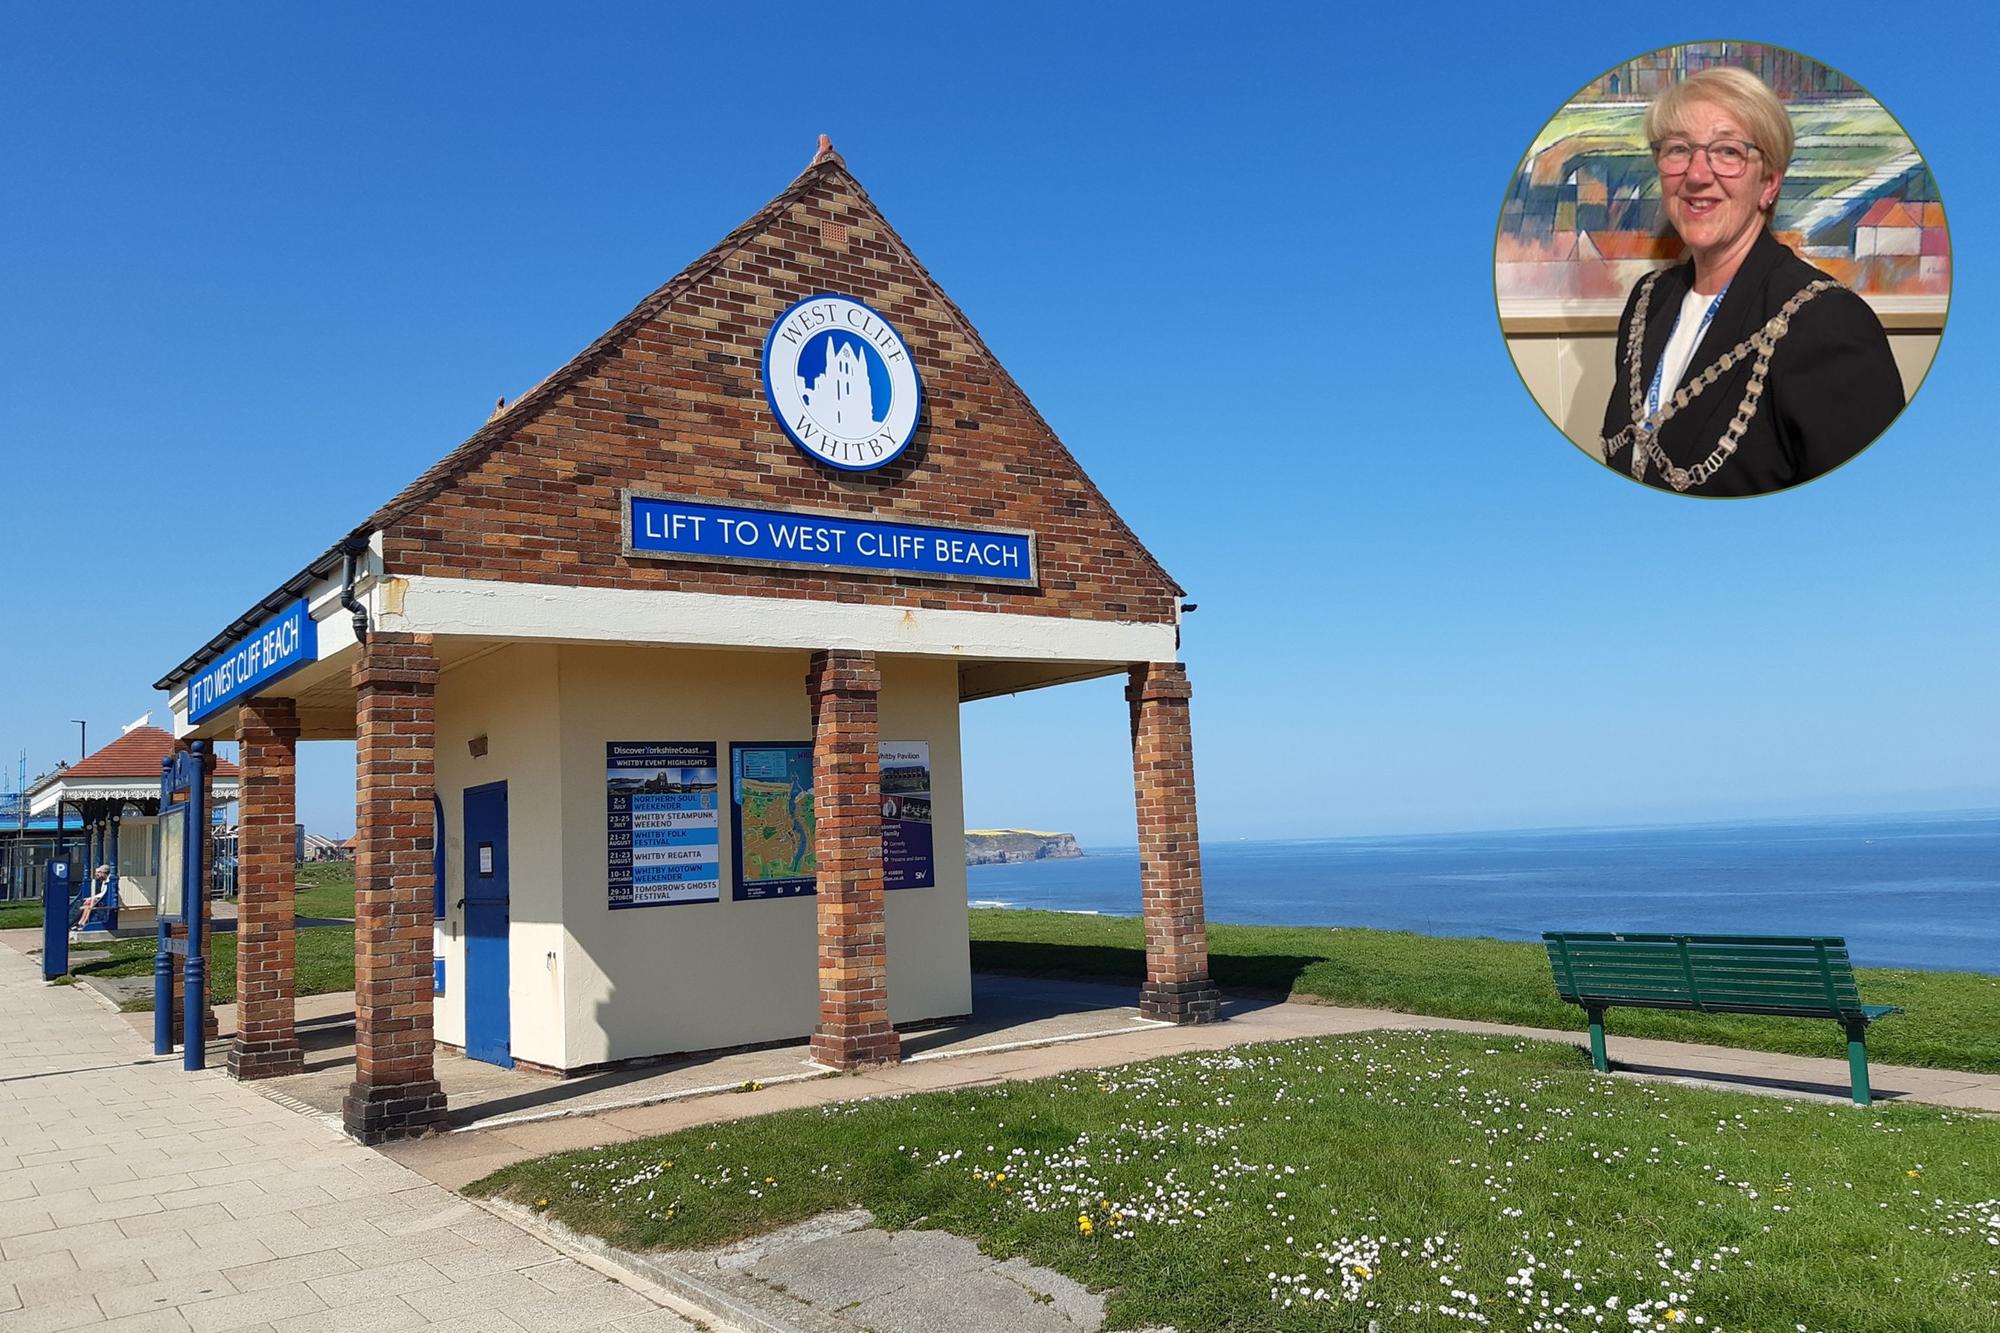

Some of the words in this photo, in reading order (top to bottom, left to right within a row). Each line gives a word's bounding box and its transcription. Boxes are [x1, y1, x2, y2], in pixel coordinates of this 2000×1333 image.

[782, 304, 837, 345] WEST
[847, 308, 905, 365] CLIFF
[795, 414, 898, 461] WHITBY
[646, 511, 706, 541] LIFT
[717, 518, 759, 546] TO
[769, 523, 846, 554] WEST
[857, 531, 926, 560] CLIFF
[936, 539, 1018, 568] BEACH
[203, 674, 214, 706] TO
[214, 657, 236, 699] WEST
[237, 639, 261, 684] CLIFF
[263, 614, 299, 669] BEACH
[879, 752, 896, 761] hitby
[897, 752, 920, 760] Pavilion
[616, 759, 644, 767] WHITBY
[667, 759, 708, 767] HIGHLIGHTS
[634, 795, 676, 803] NORTHERN
[634, 802, 682, 810] WEEKENDER
[634, 812, 666, 821] WHITBY
[667, 812, 714, 820] STEAMPUNK
[634, 820, 672, 828] WEEKEND
[634, 830, 666, 838] WHITBY
[634, 838, 670, 847] FESTIVAL
[634, 852, 666, 861] WHITBY
[667, 851, 702, 860] REGATTA
[56, 863, 65, 876] P
[610, 870, 631, 878] 10-12
[635, 866, 666, 875] WHITBY
[668, 865, 703, 873] MOTOWN
[635, 873, 683, 882] WEEKENDER
[635, 884, 686, 893] TOMORROWS
[687, 882, 717, 891] GHOSTS
[635, 892, 671, 901] FESTIVAL
